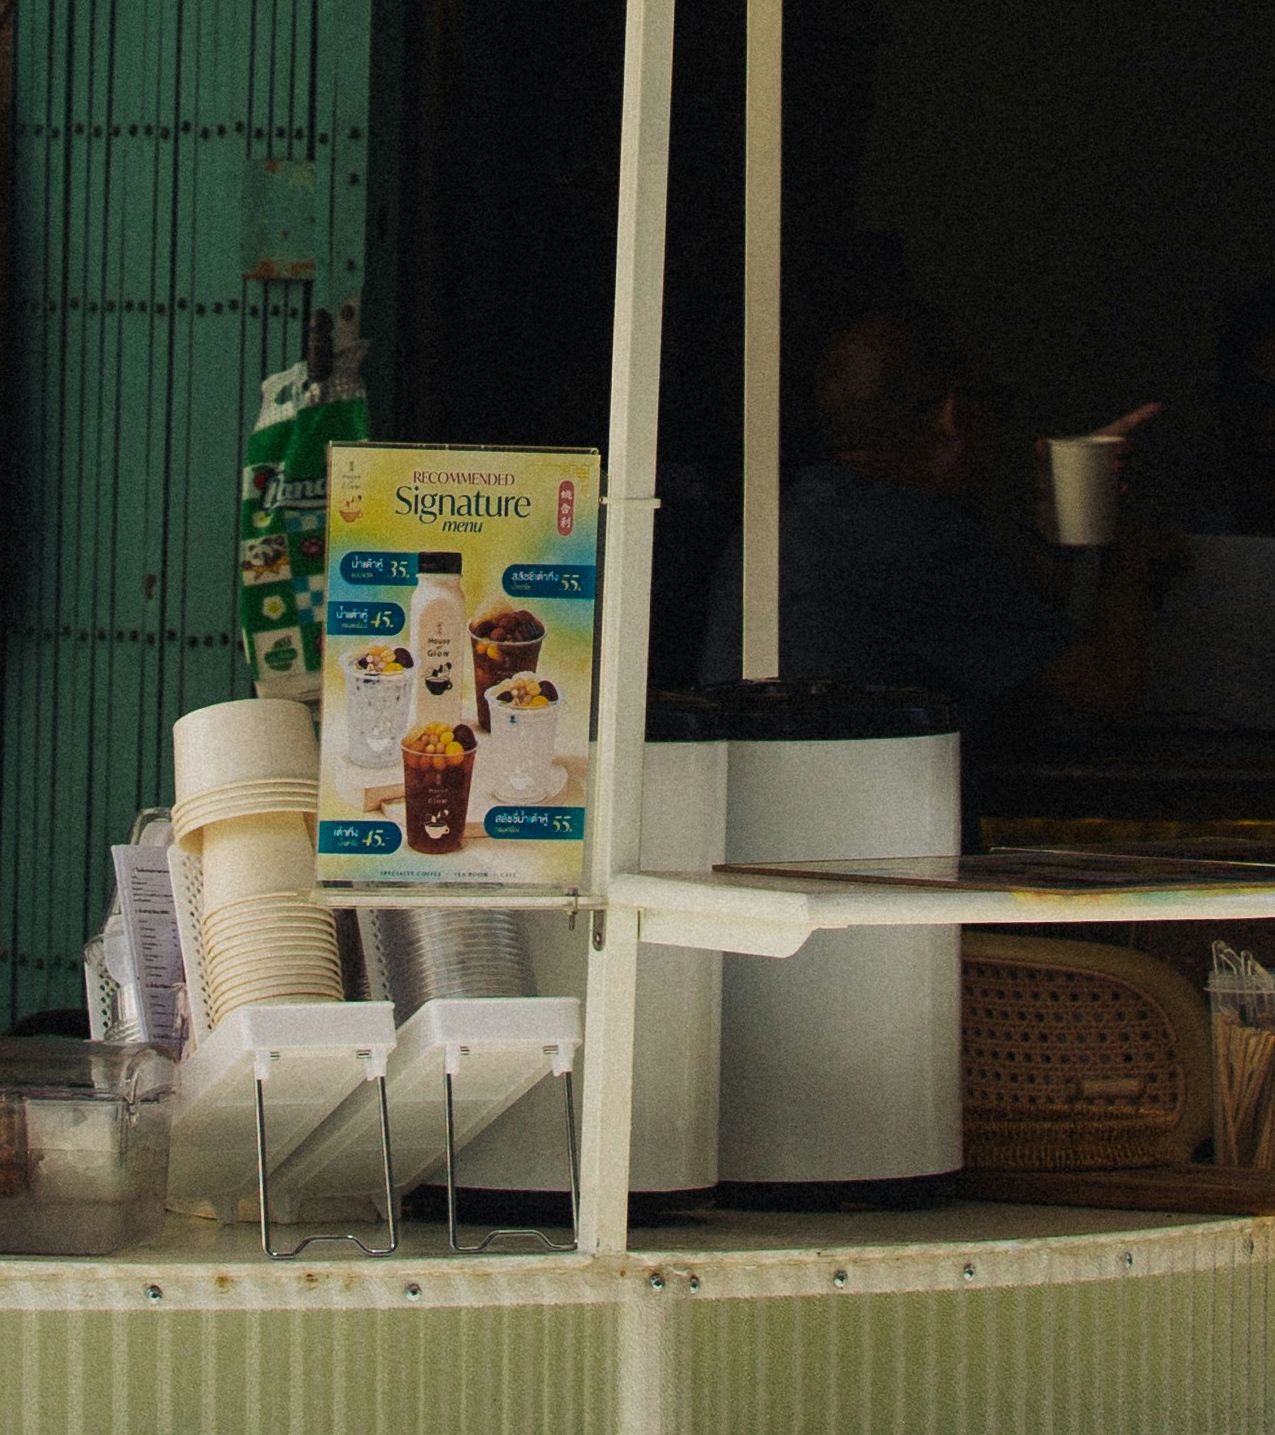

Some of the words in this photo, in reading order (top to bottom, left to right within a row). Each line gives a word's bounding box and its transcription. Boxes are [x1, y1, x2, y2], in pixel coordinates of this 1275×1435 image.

[413, 471, 515, 486] RECOMMENDED
[395, 485, 531, 524] Signature
[442, 519, 483, 533] menu
